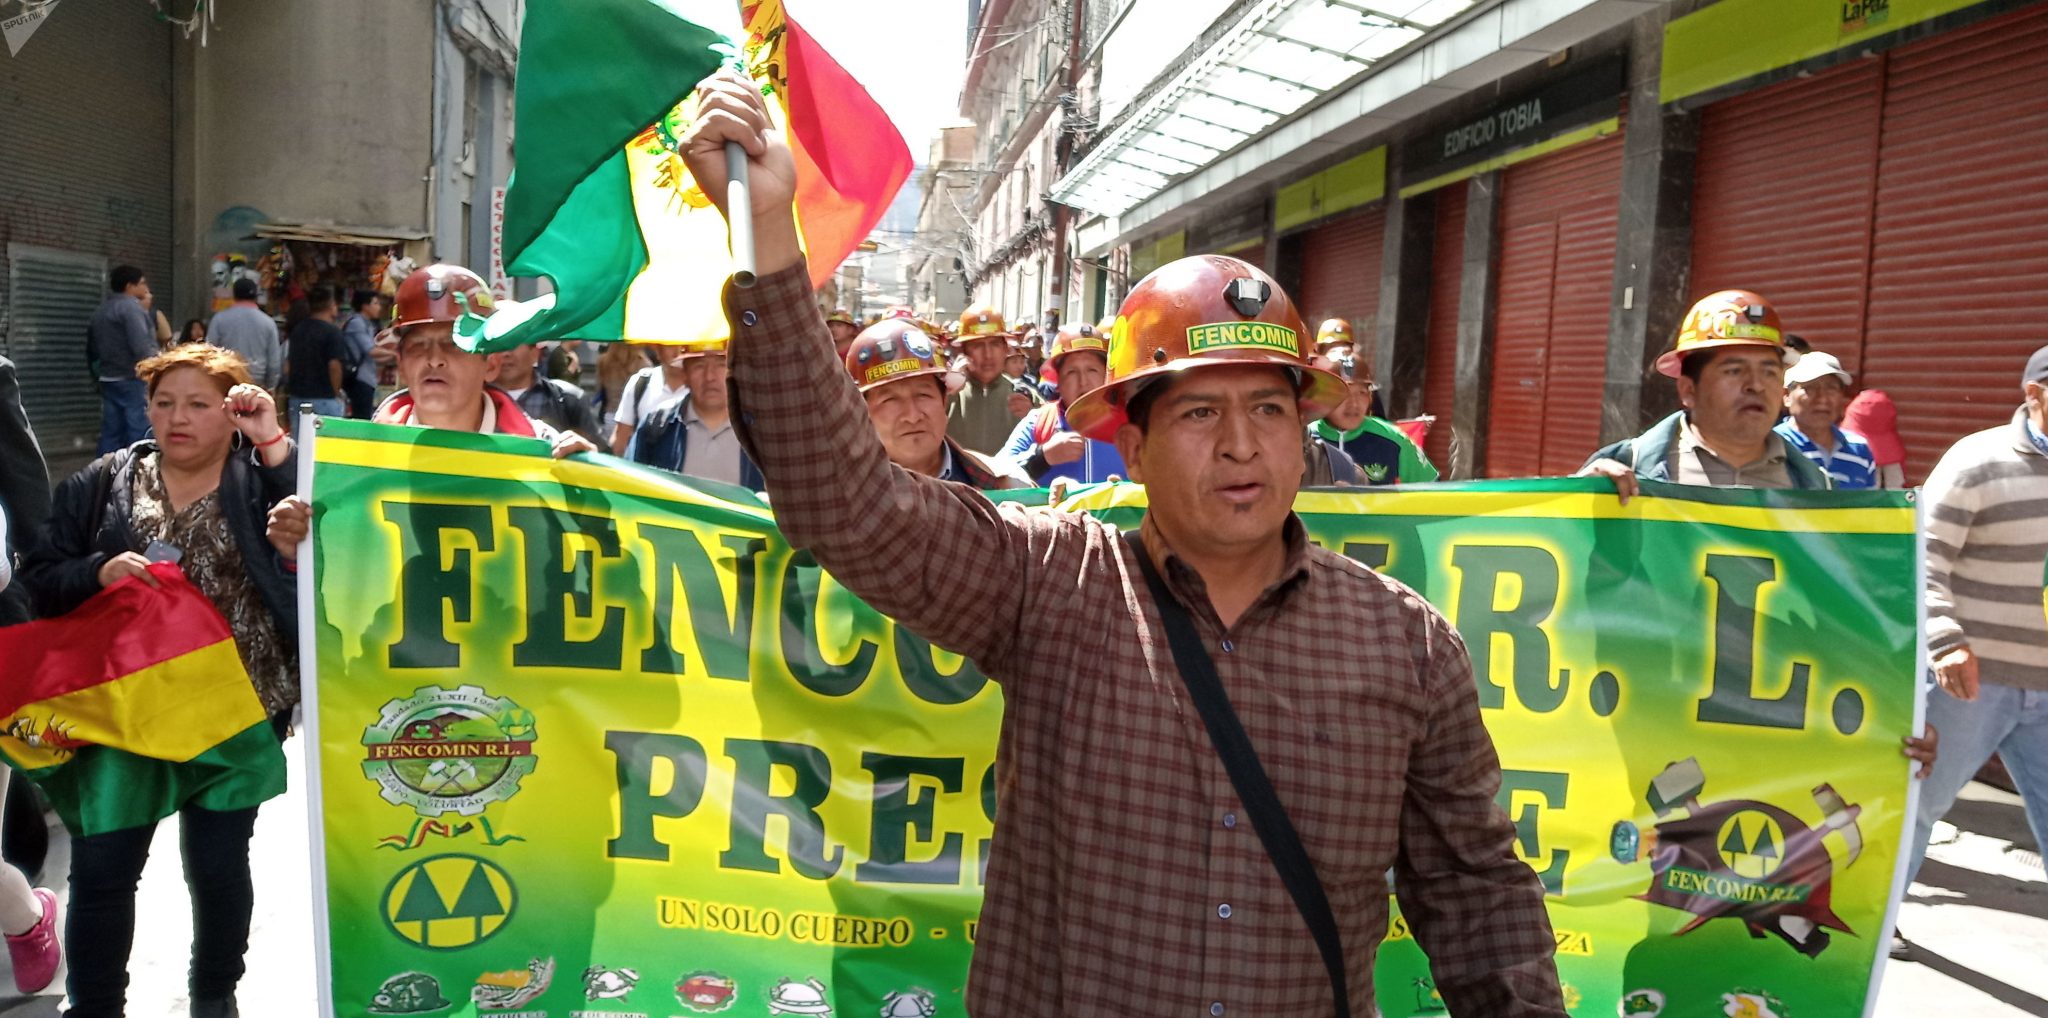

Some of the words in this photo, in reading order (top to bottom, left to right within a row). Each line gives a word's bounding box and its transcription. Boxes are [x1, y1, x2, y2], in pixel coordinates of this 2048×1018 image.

[1444, 116, 1496, 157] EDIFICIO
[1499, 98, 1542, 137] TOBIA
[1192, 325, 1297, 350] FENCOMIN
[868, 360, 919, 380] FENCOMIN
[1697, 553, 1865, 735] L.
[375, 744, 479, 759] FENCOMIN
[486, 743, 521, 756] R.L.
[1668, 869, 1769, 900] FENCOMIN
[660, 899, 697, 925] UN
[706, 904, 780, 936] SOLO
[791, 914, 910, 944] CUERPO
